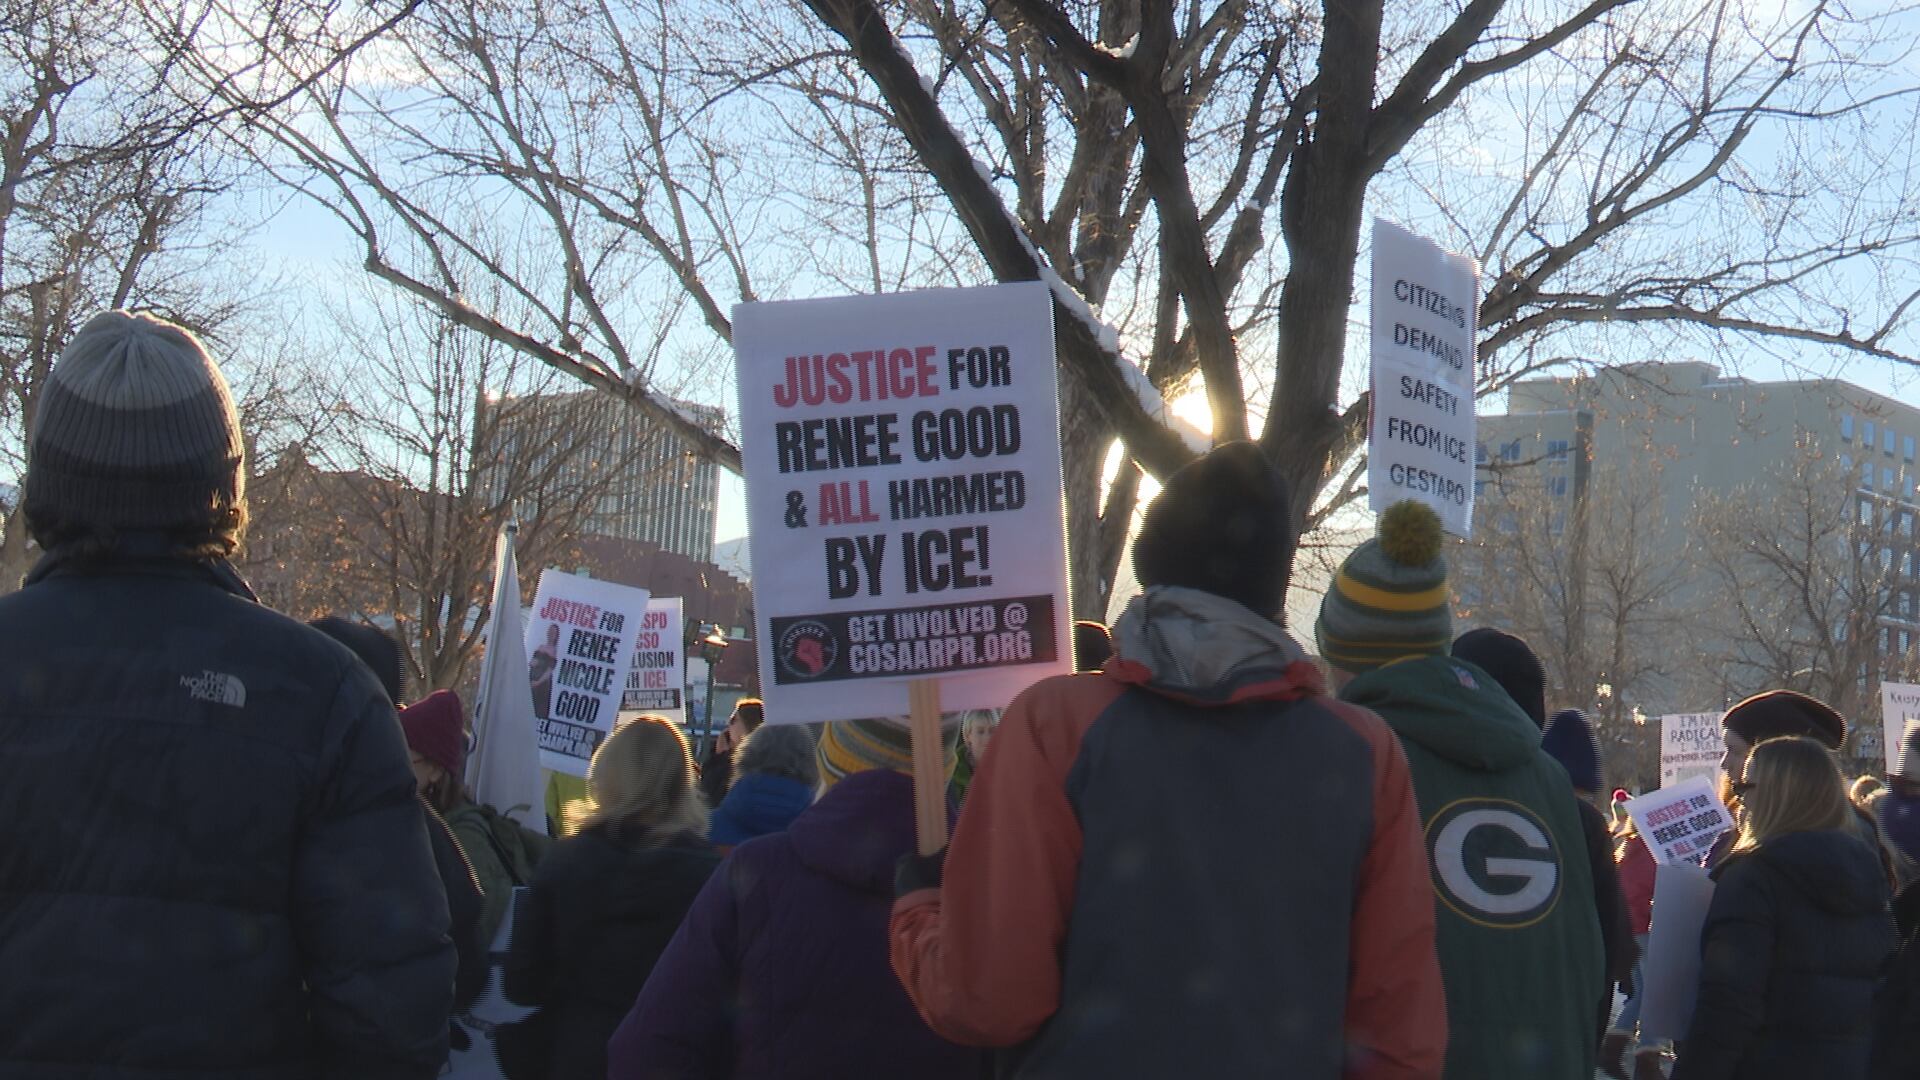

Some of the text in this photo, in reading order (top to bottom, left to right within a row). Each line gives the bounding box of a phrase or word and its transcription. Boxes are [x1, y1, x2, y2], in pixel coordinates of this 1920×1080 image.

[1394, 279, 1465, 329] CITIZENS
[1394, 322, 1463, 370] DEMAND
[774, 346, 1011, 407] JUSTICE FOR
[1400, 375, 1458, 416] SAFETY
[776, 404, 1021, 473] RENEE GOOD
[1388, 416, 1466, 464] FROM ICE
[784, 470, 1026, 528] & ALL HARMED
[1389, 463, 1465, 506] GESTAPO
[825, 525, 992, 600] BY ICE!
[540, 597, 625, 634] JUSTICE FOR
[641, 611, 668, 630] SPD
[849, 613, 886, 643] GET
[894, 605, 996, 640] INVOLVED
[1003, 602, 1029, 631] @
[567, 628, 621, 664] RENEE
[630, 651, 674, 669] LUSION
[849, 630, 1032, 674] COSAARPR.ORG
[180, 675, 224, 695] NORTH
[557, 658, 615, 695] NICOLE
[643, 670, 667, 689] ICE!
[555, 690, 601, 724] GOOD
[1670, 727, 1722, 743] RADICAL
[1646, 794, 1711, 828] JUSTICE FOR
[1652, 809, 1722, 845] RENEE GOOD
[1434, 808, 1557, 914] G
[1672, 840, 1697, 856] ALL
